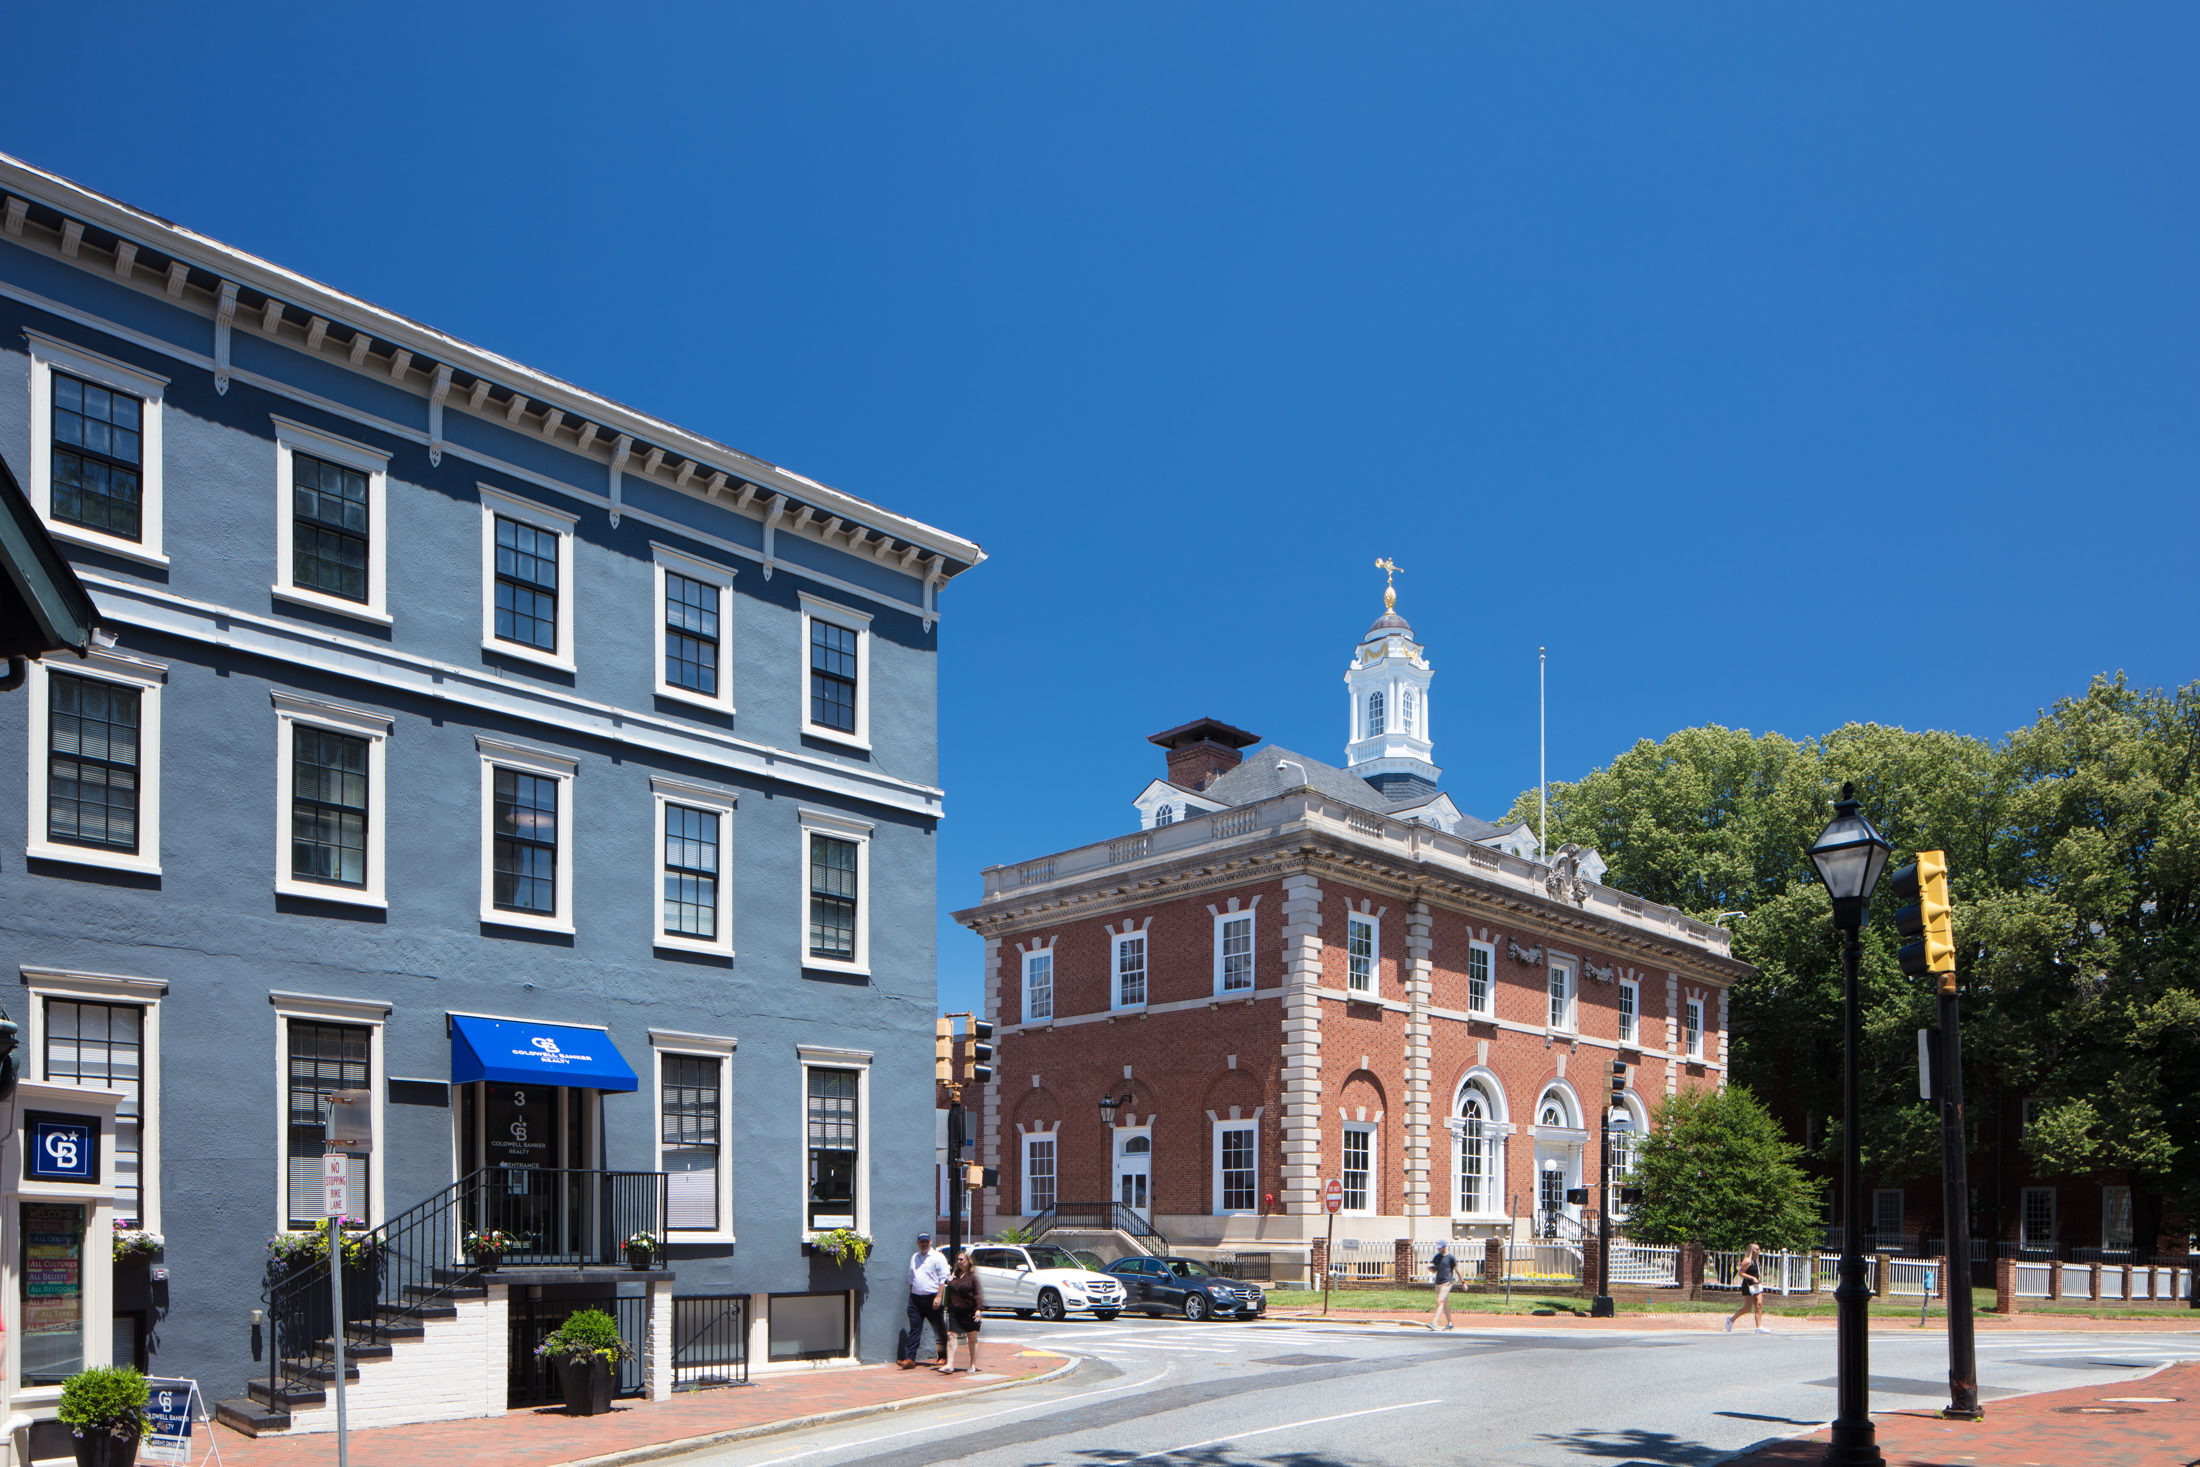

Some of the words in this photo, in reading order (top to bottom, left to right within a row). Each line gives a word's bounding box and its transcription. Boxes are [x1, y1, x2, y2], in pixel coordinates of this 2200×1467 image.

[512, 1049, 558, 1058] COLDWELL
[558, 1053, 592, 1061] BANKER
[514, 1090, 526, 1107] 3
[491, 1140, 523, 1148] COLDWELL
[45, 1131, 78, 1169] CB
[331, 1162, 339, 1173] NO
[507, 1161, 540, 1169] ENTRANCE
[326, 1176, 345, 1186] STOPPING
[331, 1189, 341, 1198] BIKE
[330, 1199, 342, 1210] LANE
[28, 1209, 76, 1220] WELCOME
[45, 1322, 75, 1331] PEOPLE
